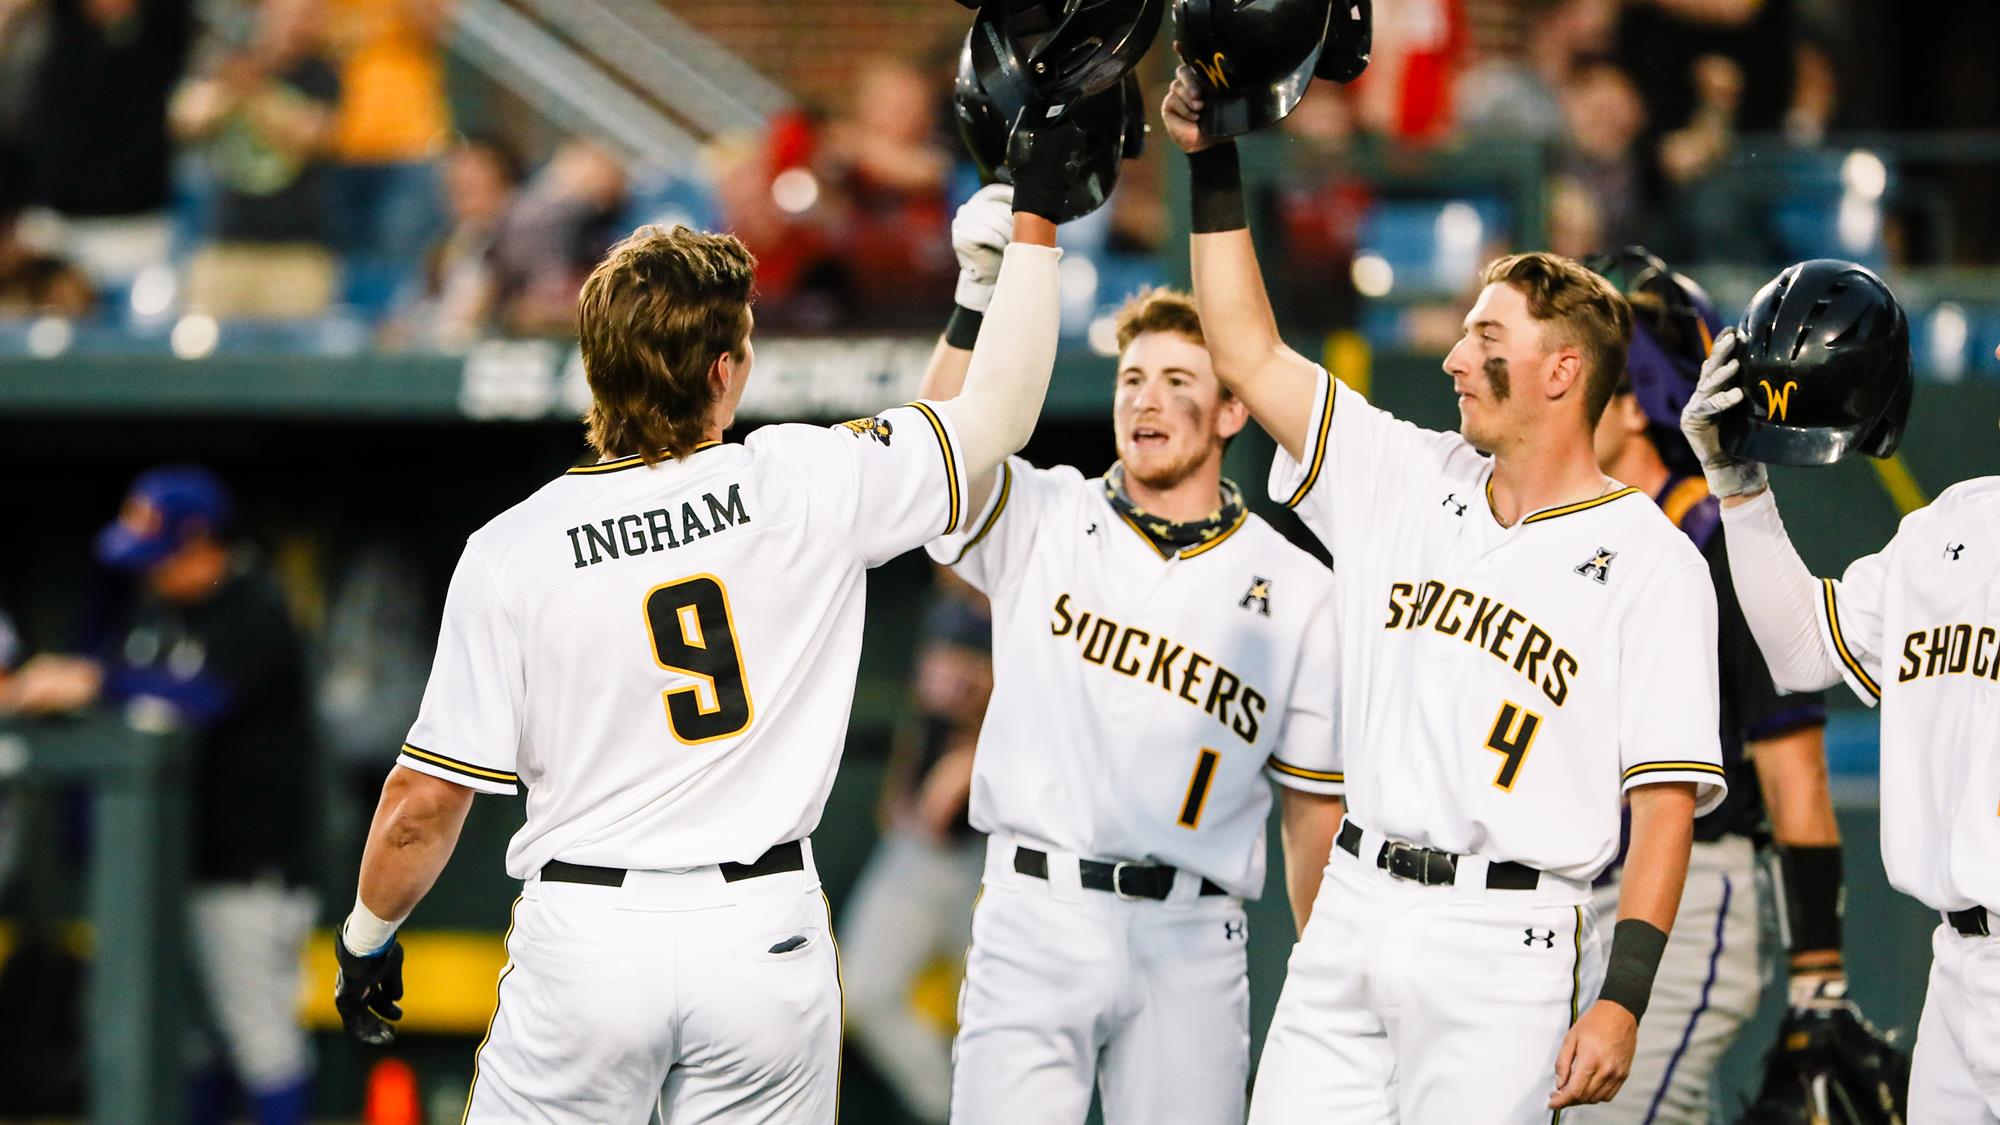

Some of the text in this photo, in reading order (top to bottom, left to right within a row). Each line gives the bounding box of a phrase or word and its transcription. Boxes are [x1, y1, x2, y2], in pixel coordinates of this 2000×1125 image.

[1195, 52, 1230, 89] W
[1759, 379, 1798, 422] W
[567, 483, 751, 569] INGRAM
[641, 572, 755, 747] 9
[1176, 746, 1222, 832] 1
[1482, 699, 1545, 795] 4
